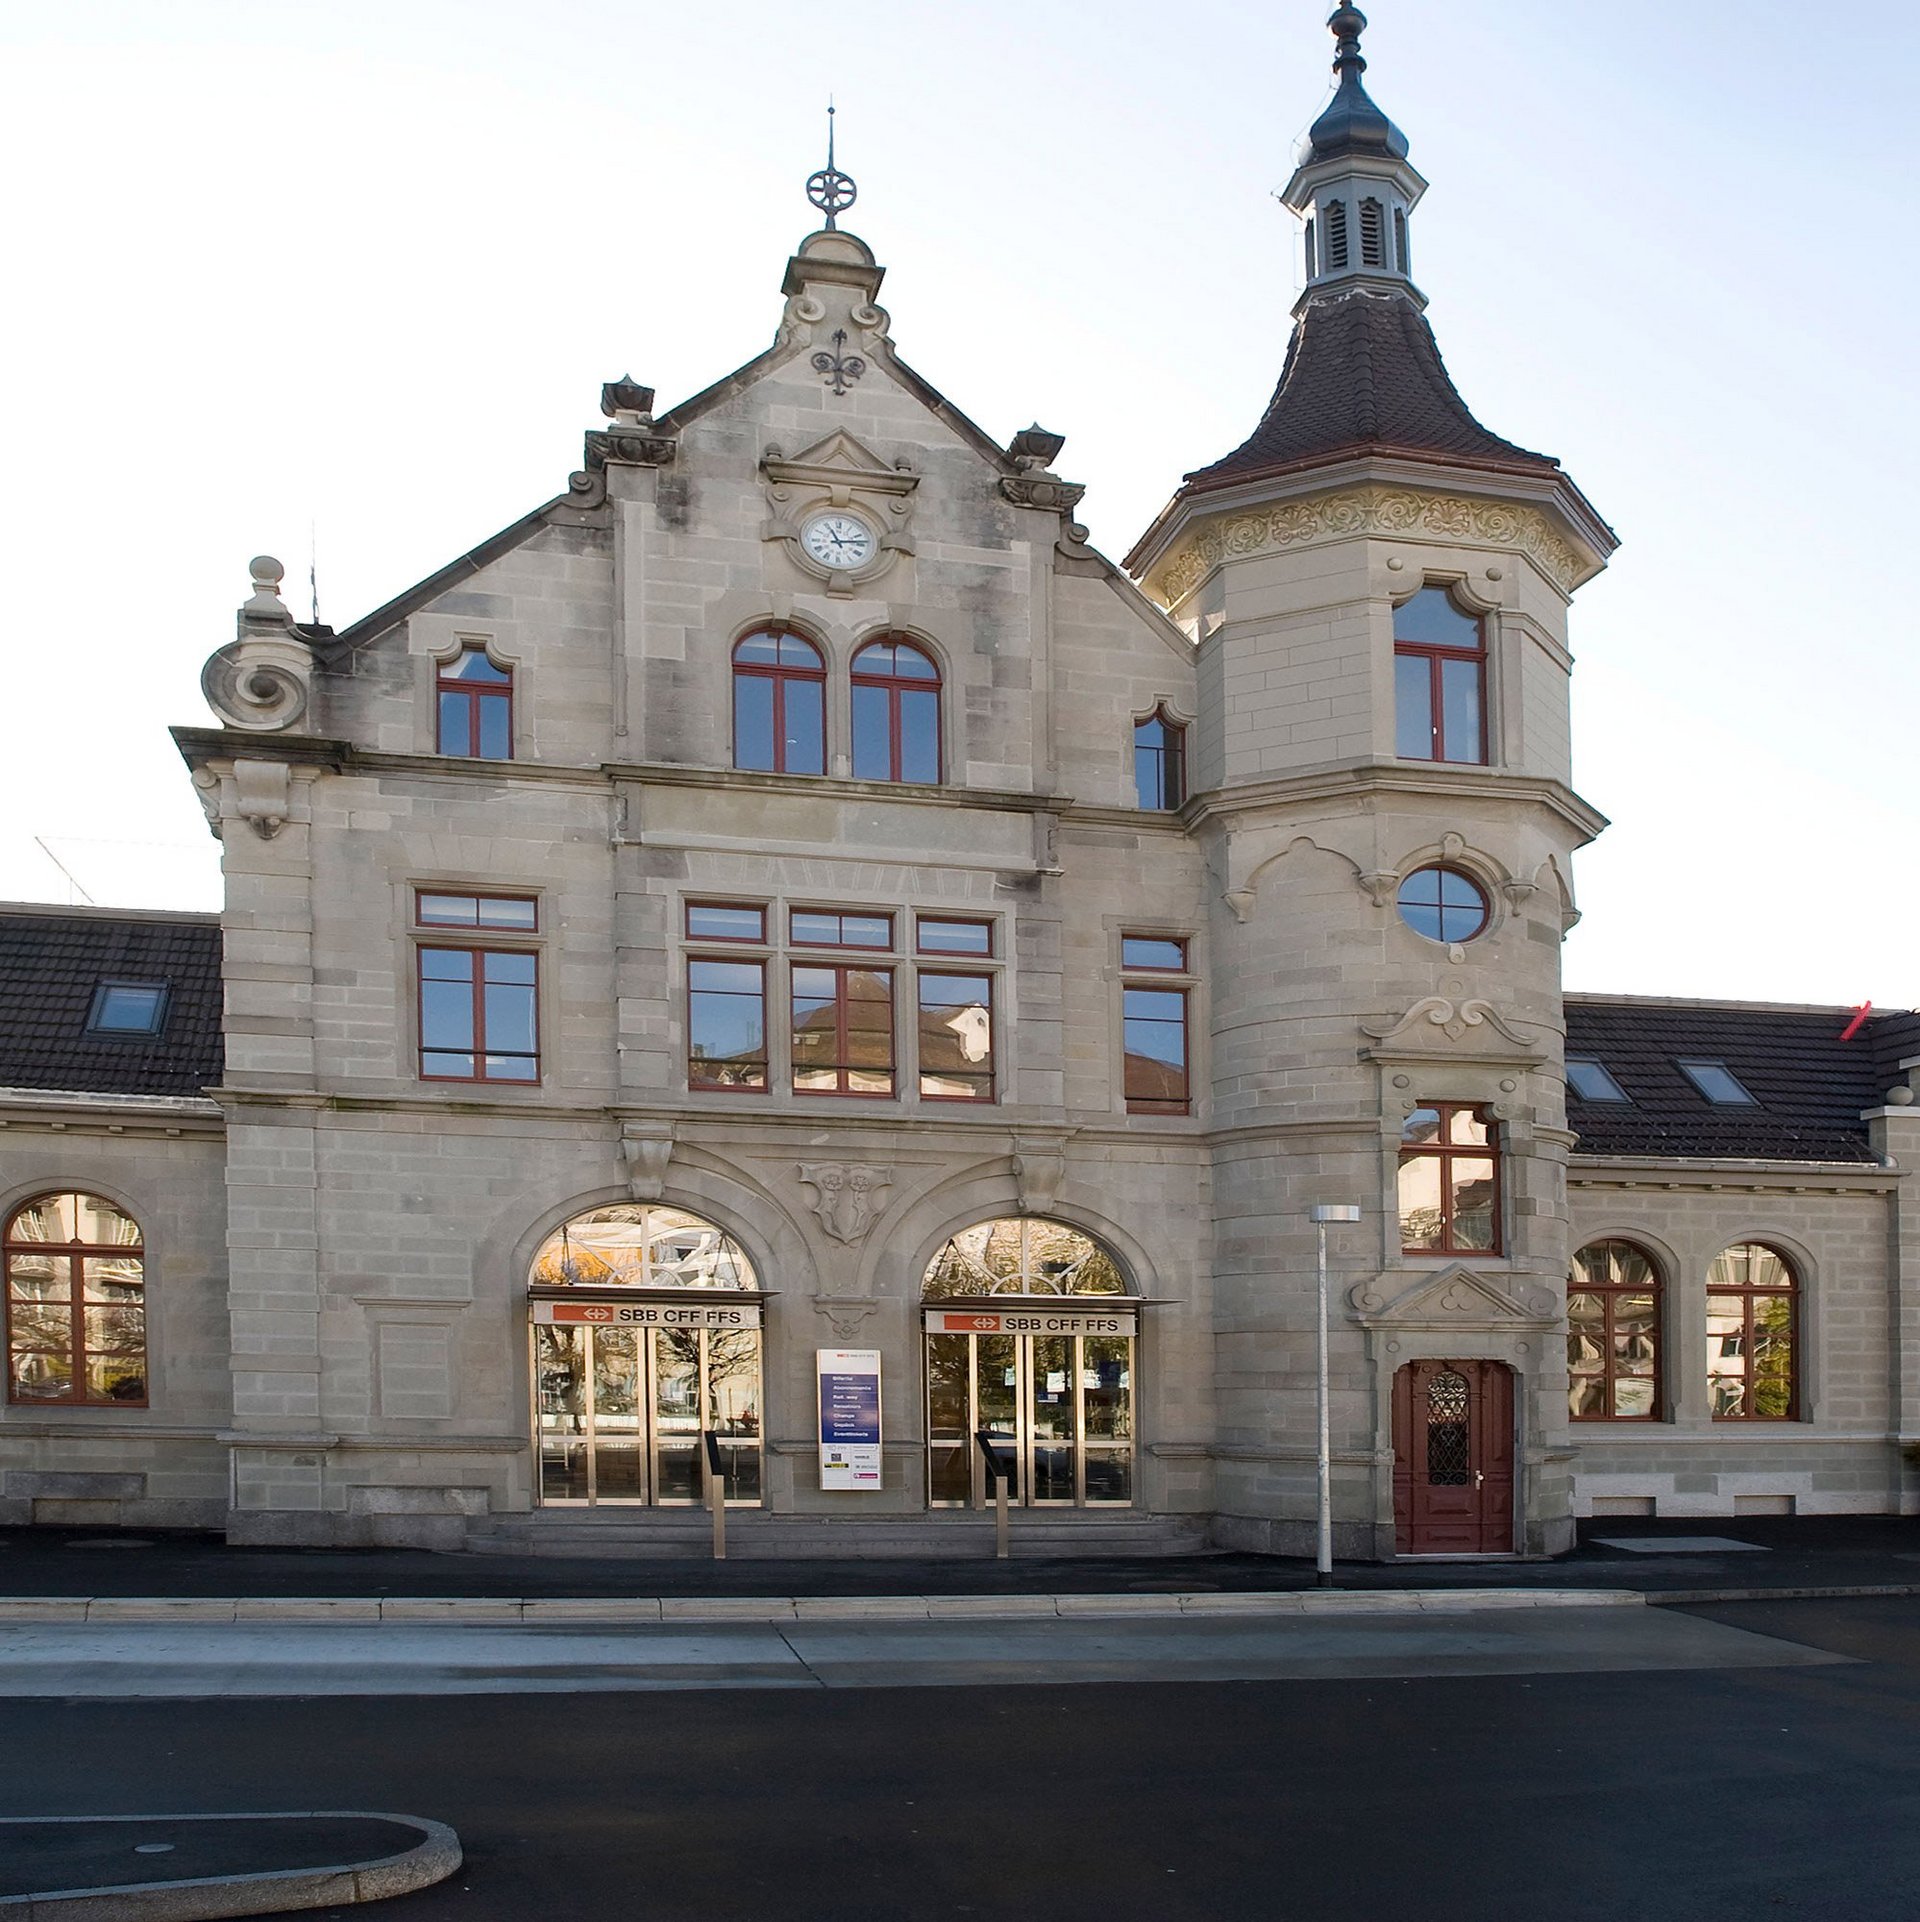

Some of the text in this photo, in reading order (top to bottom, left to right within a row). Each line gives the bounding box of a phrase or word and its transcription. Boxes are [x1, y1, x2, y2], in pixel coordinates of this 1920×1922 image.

[619, 1308, 741, 1324] SBB CFF FFS
[1005, 1318, 1119, 1331] SBB CFF FFS
